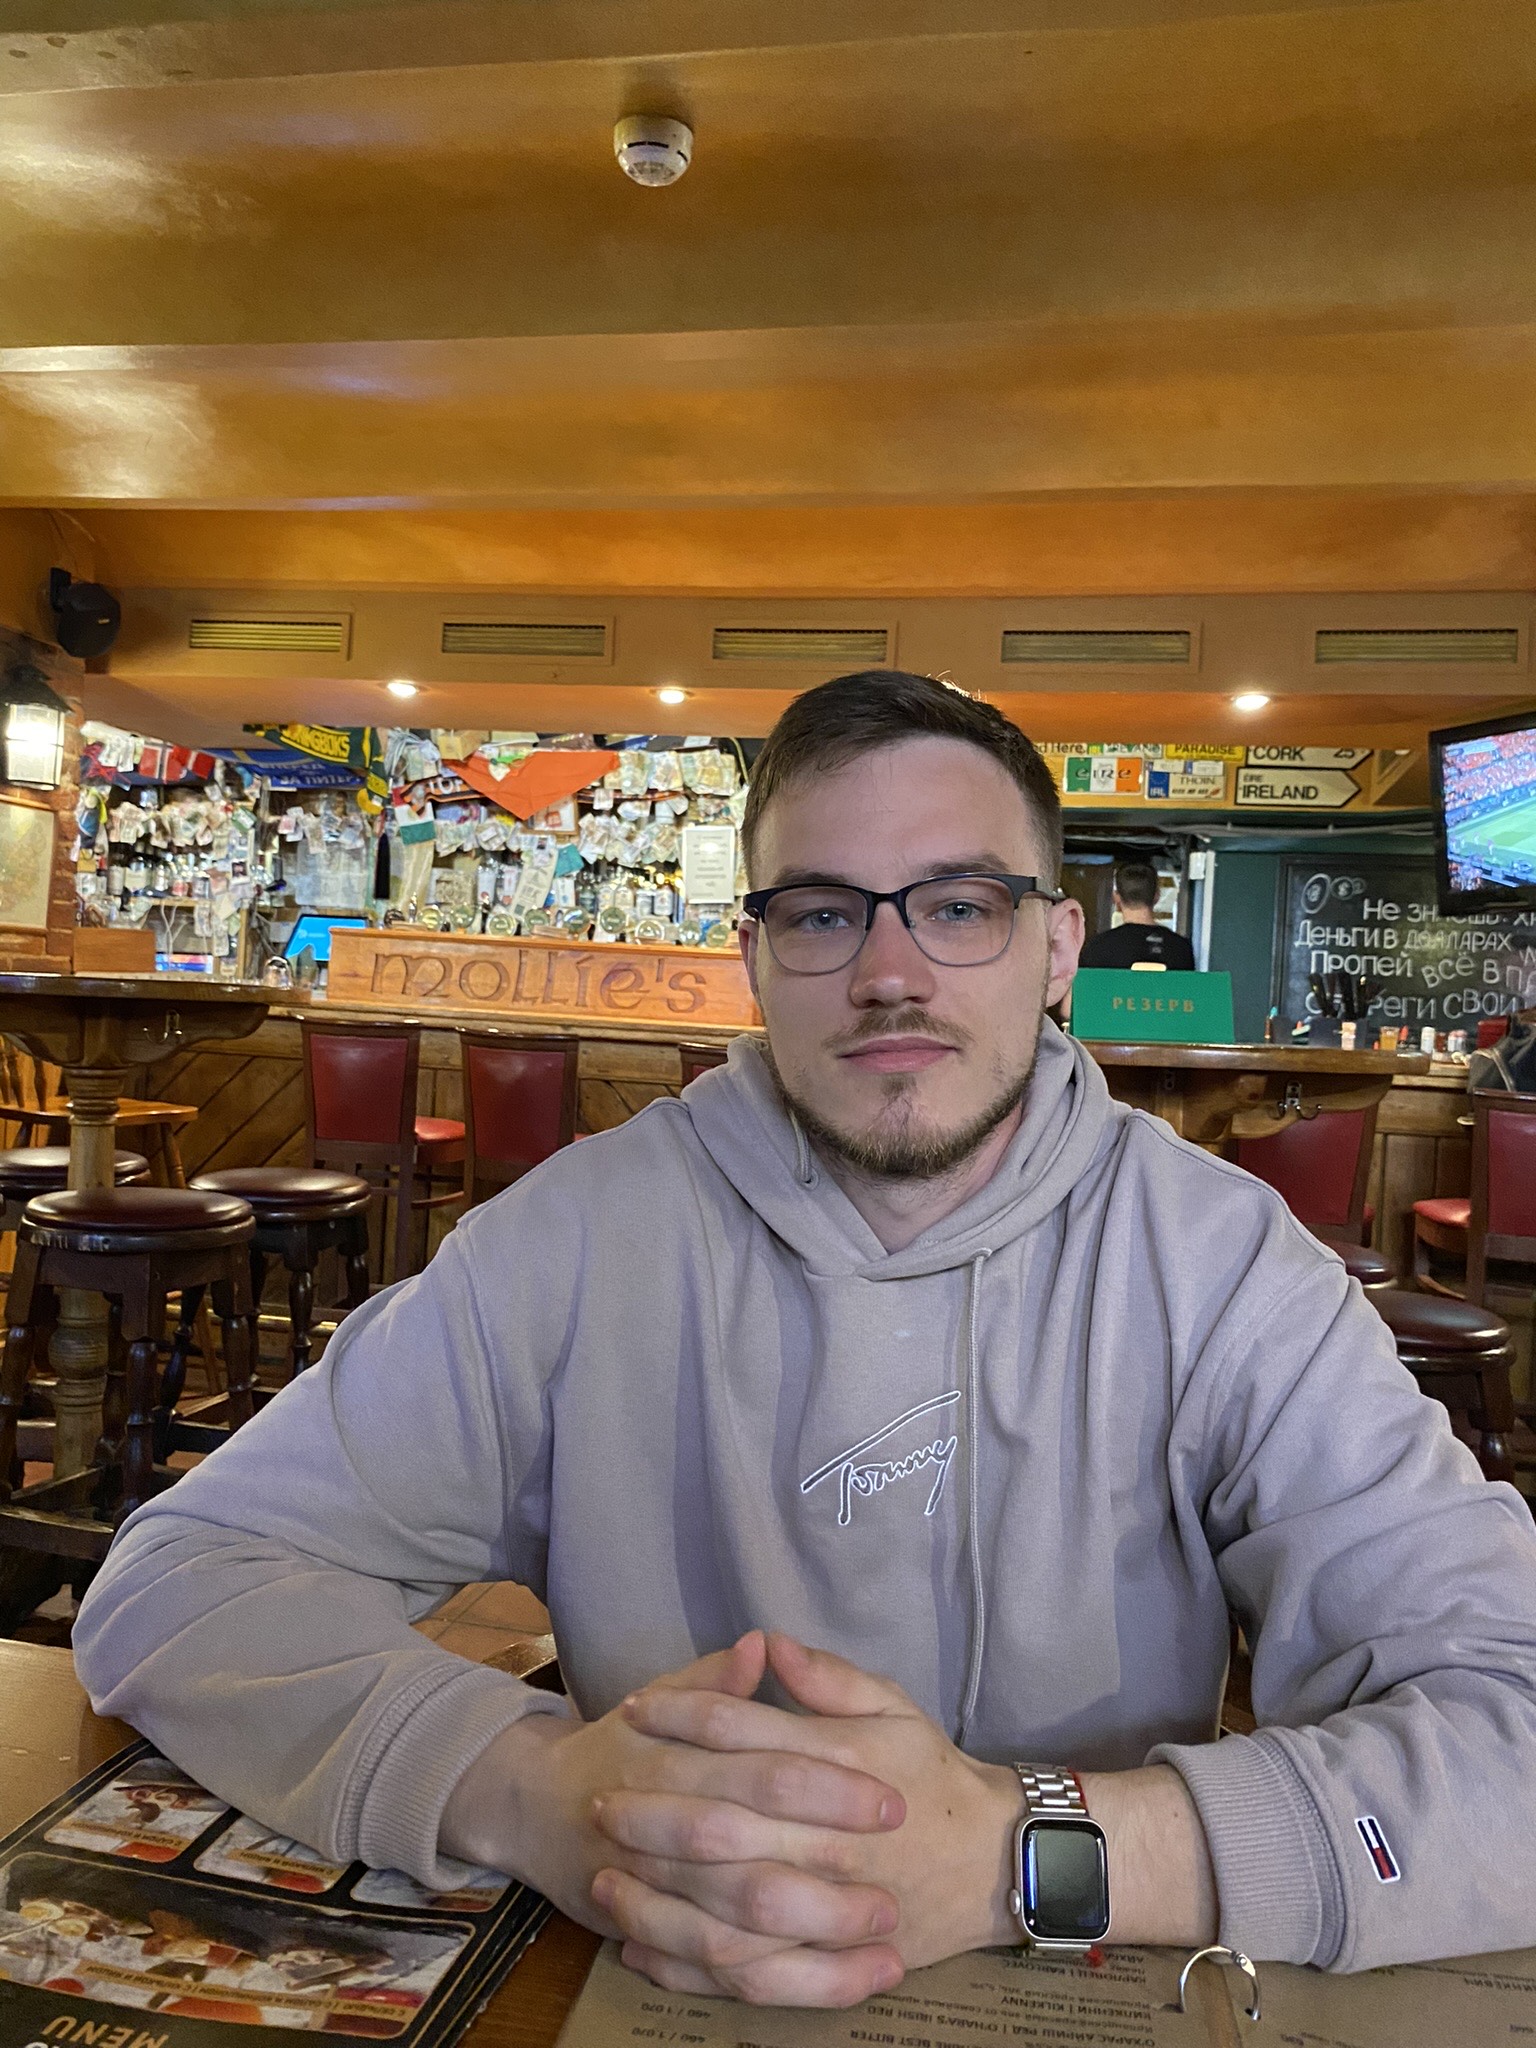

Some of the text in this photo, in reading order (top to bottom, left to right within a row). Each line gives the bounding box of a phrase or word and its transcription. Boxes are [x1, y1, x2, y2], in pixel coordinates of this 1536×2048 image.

[1174, 744, 1236, 755] PARADISE
[1253, 746, 1304, 761] CORK
[1242, 784, 1319, 800] IRELAND
[1362, 898, 1401, 922] Не
[1294, 919, 1380, 949] Деньги
[1310, 950, 1414, 978] Пропей
[1111, 997, 1195, 1013] РЕЗЕРВ
[801, 1390, 961, 1525] Tommy
[1001, 1996, 1065, 2012] KILKENNY
[40, 2015, 170, 2048] MENU
[850, 2029, 895, 2045] BITTER
